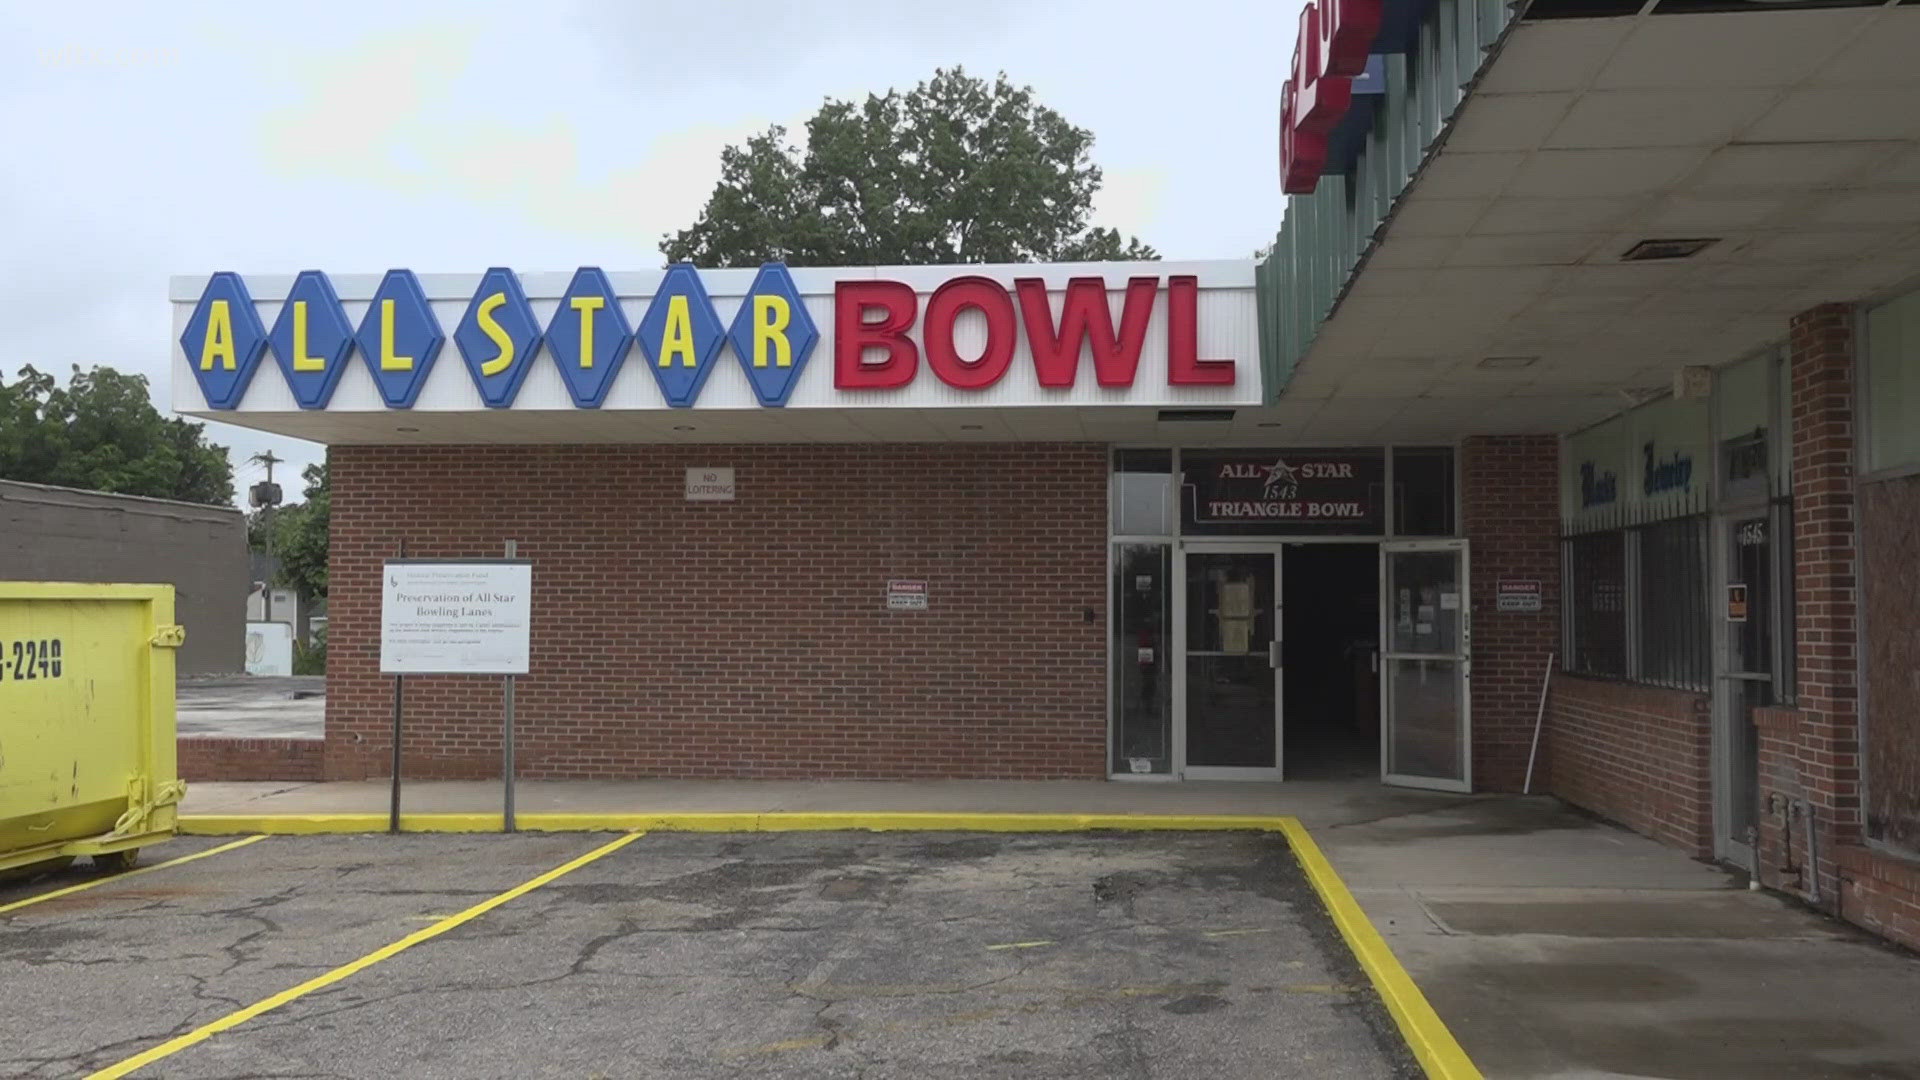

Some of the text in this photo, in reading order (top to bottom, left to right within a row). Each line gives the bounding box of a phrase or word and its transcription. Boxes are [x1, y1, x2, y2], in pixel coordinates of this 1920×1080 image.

[200, 275, 1236, 390] ALL STAR BOWL
[1219, 463, 1353, 478] ALL STAR
[703, 473, 717, 482] NO
[688, 485, 733, 494] LOITERING
[1262, 485, 1298, 500] 1543
[1209, 502, 1364, 517] TRIANGLE BOWL
[396, 592, 516, 603] Preservation of All Star
[416, 607, 493, 618] Bowling Lanes
